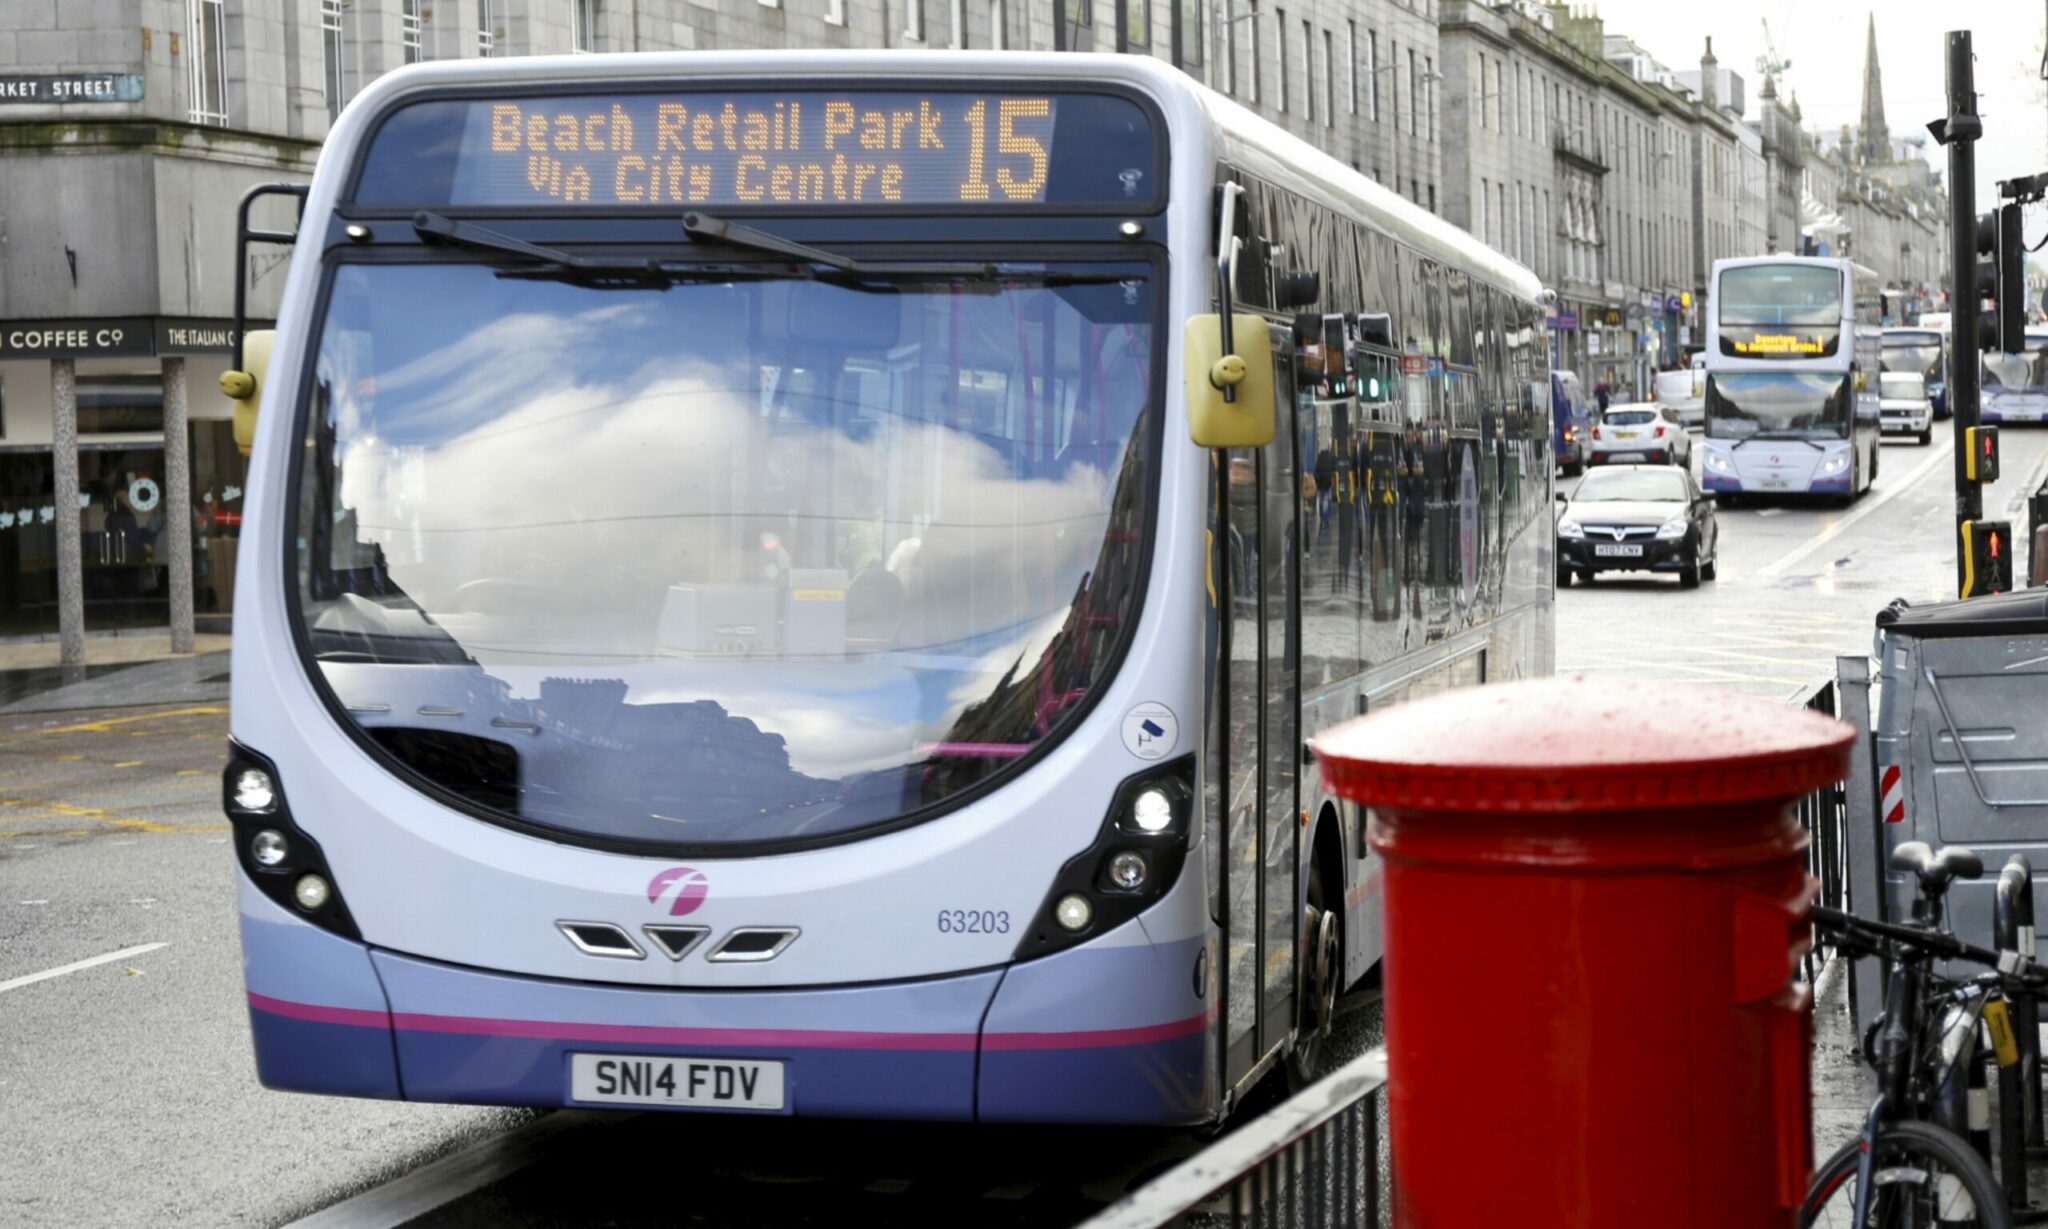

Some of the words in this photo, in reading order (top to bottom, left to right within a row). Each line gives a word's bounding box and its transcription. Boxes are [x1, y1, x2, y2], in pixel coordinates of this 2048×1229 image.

[491, 103, 635, 153] Beach
[657, 102, 802, 151] Retail
[823, 101, 945, 150] Park
[959, 99, 1050, 200] 15
[615, 154, 713, 201] City
[735, 153, 904, 201] Centre
[9, 329, 89, 349] COFFEE
[168, 328, 187, 346] THE
[188, 328, 226, 347] ITALIAN
[937, 910, 1011, 935] 63203
[596, 1060, 676, 1098] SN14
[688, 1063, 760, 1101] FDV
